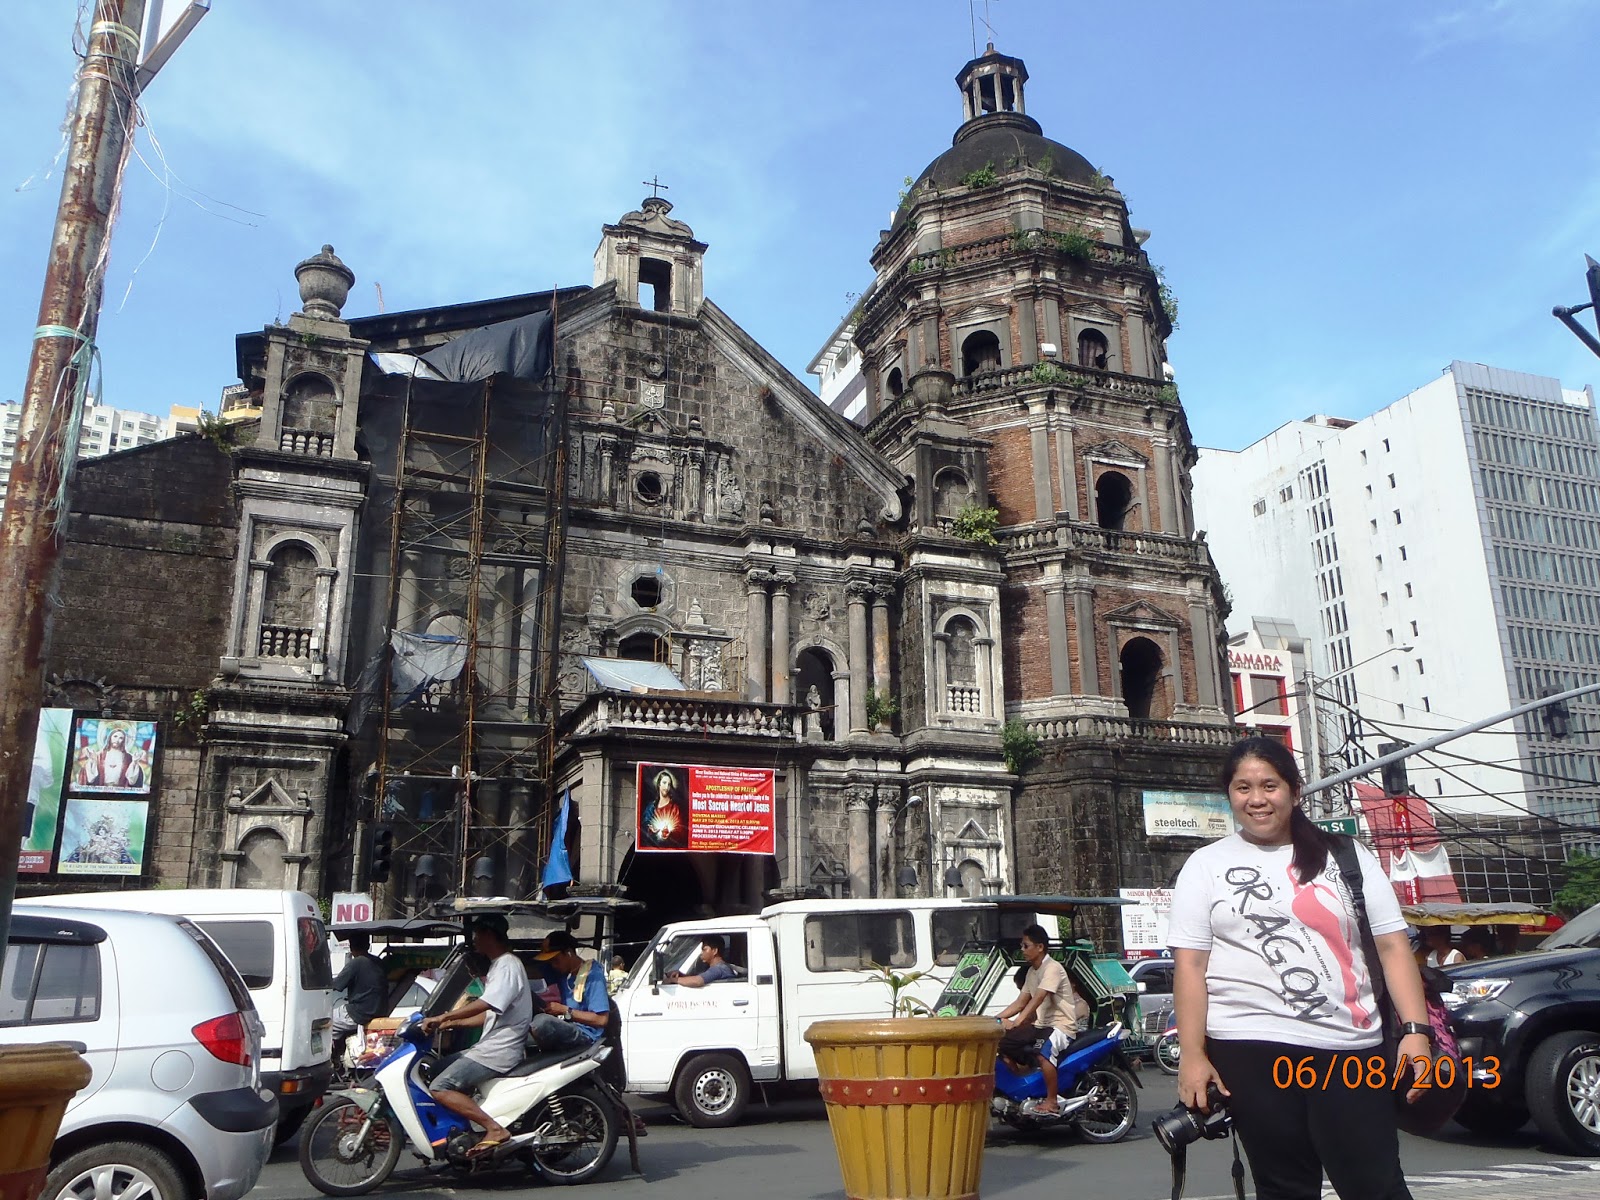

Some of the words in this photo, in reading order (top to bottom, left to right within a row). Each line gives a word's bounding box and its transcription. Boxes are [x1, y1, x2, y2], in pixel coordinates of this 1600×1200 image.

[1228, 650, 1283, 666] RAMADA
[692, 799, 706, 810] Most
[709, 800, 728, 811] Sacred
[731, 801, 746, 812] Heart
[746, 802, 752, 811] of
[754, 802, 770, 812] Jesus
[1154, 818, 1198, 828] steeltech
[1331, 822, 1345, 832] St
[336, 904, 369, 922] NO
[1225, 866, 1332, 1020] ORAGON
[1312, 945, 1333, 982] PHILIPPINES
